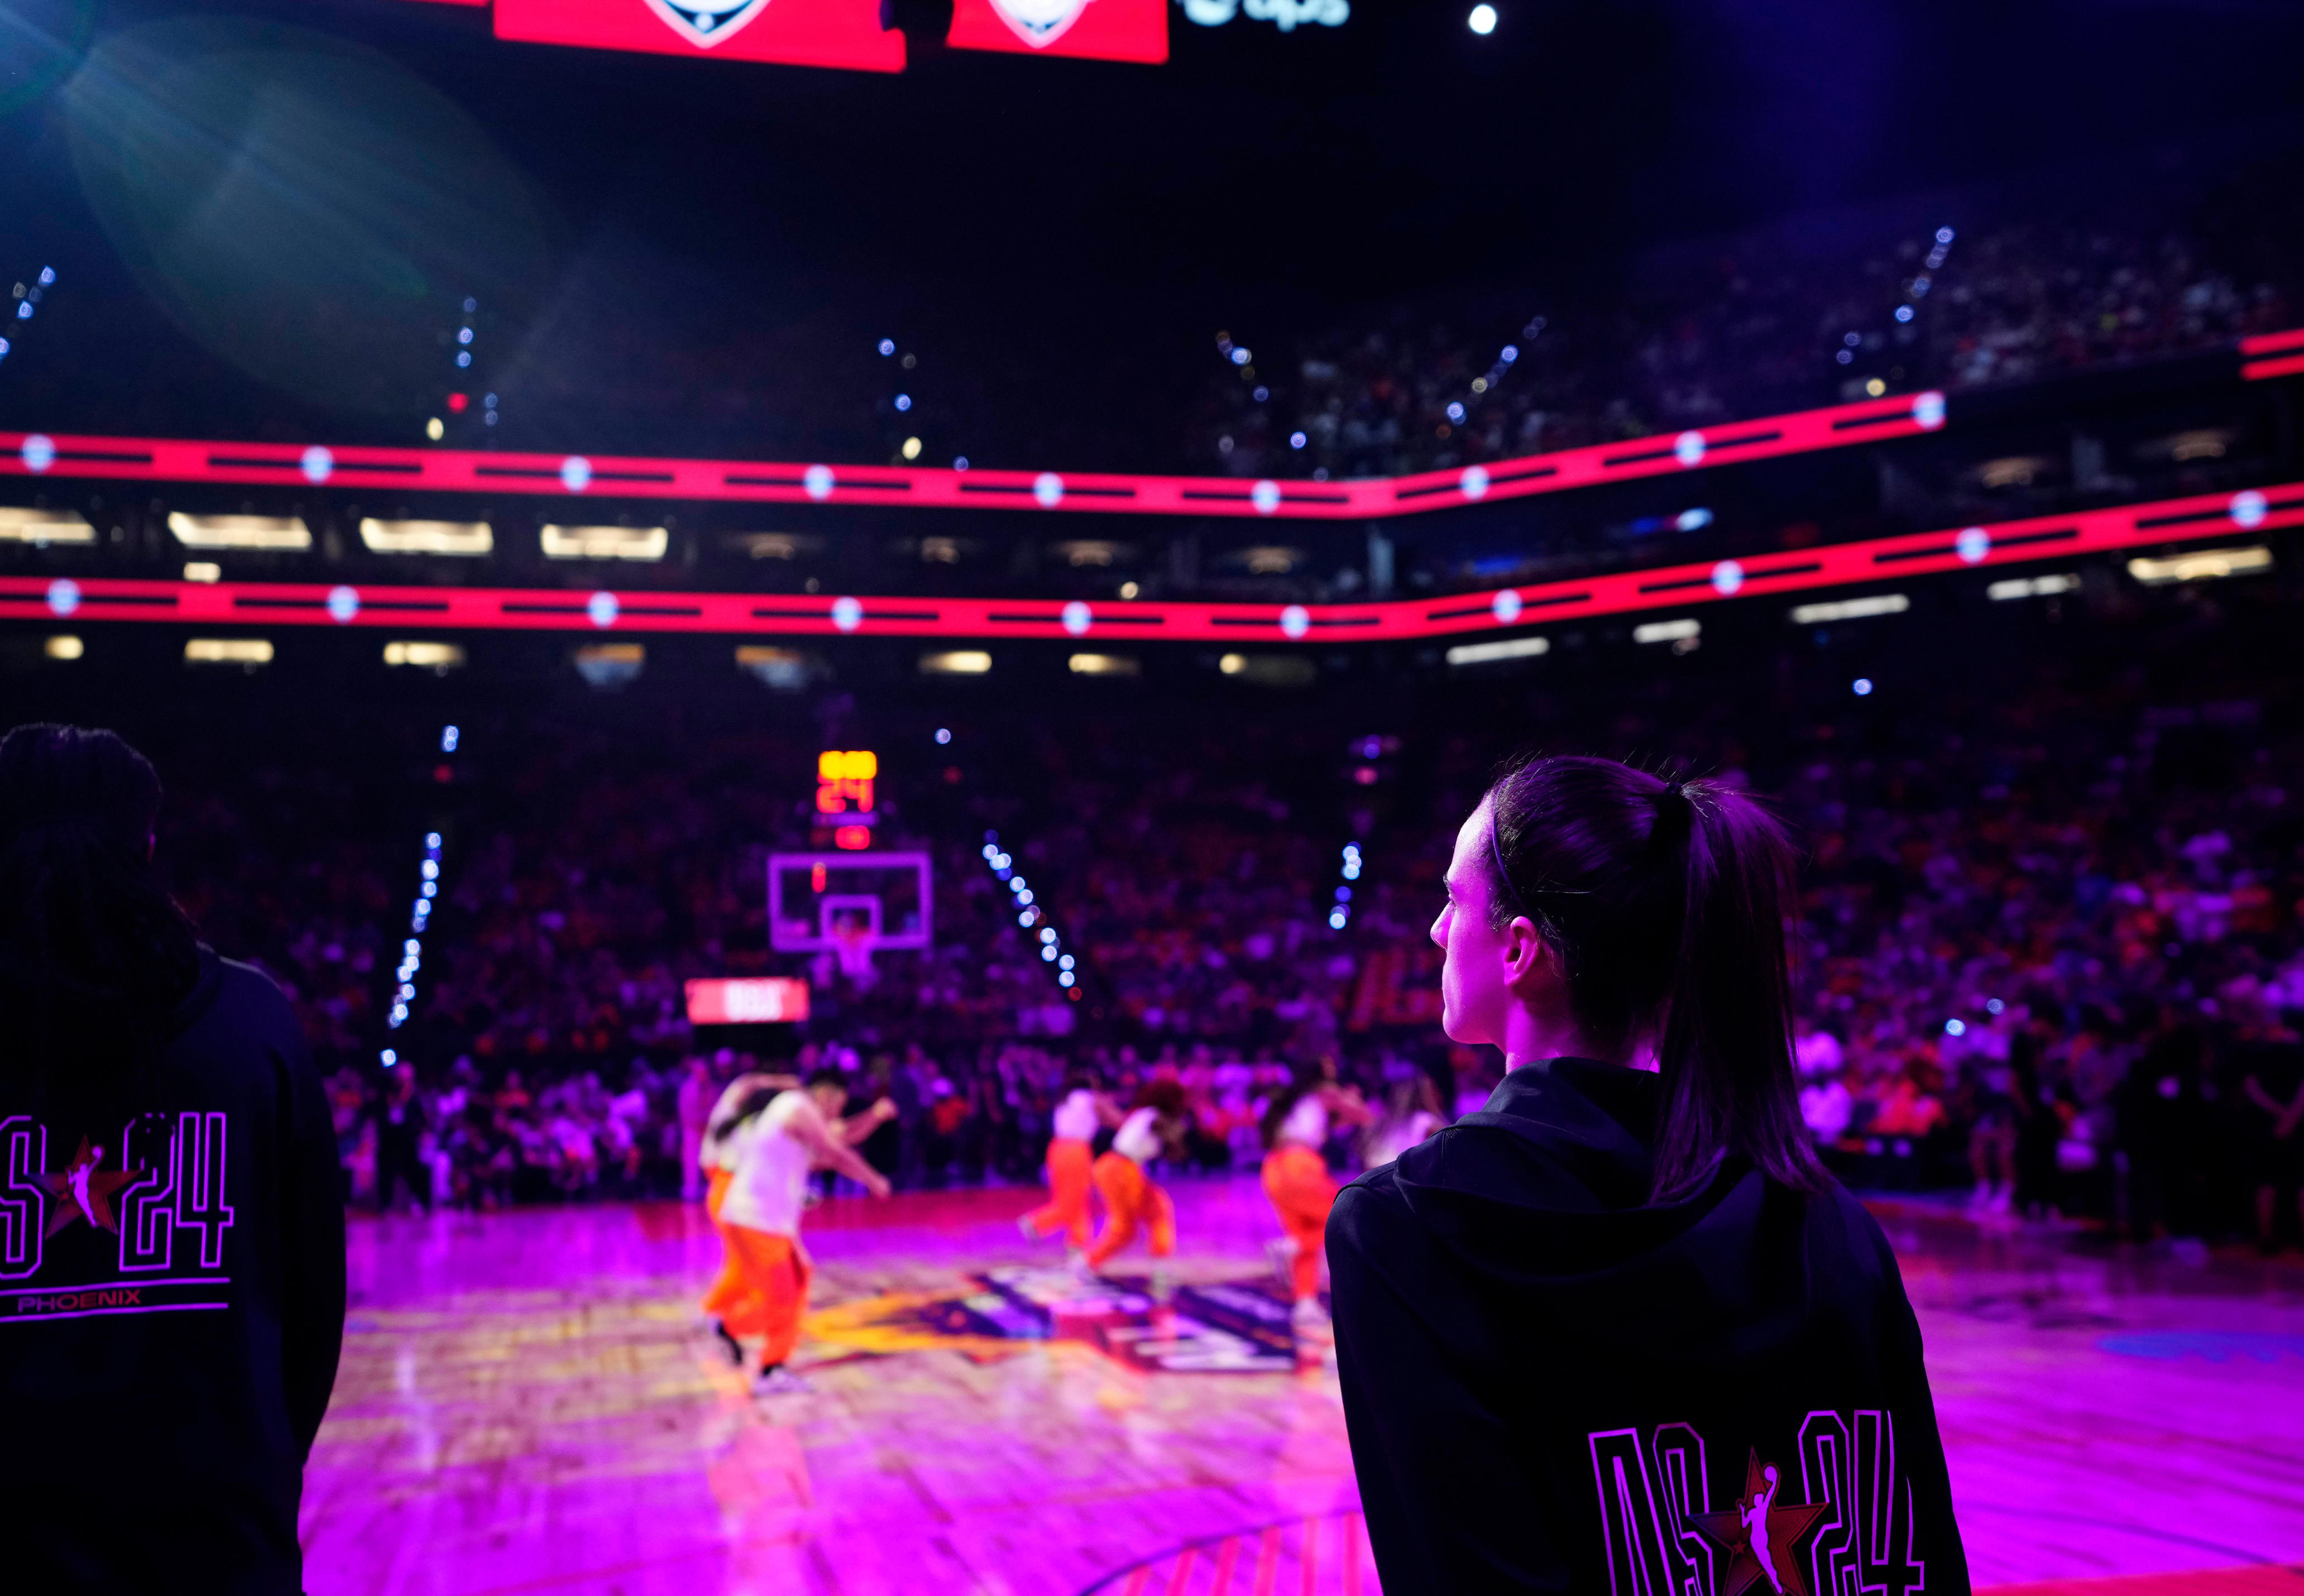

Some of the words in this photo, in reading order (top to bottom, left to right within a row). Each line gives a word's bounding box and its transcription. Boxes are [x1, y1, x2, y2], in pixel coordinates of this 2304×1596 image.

[118, 1112, 234, 1272] 24
[17, 1288, 142, 1312] PHOENIX
[1797, 1410, 1924, 1596] 24
